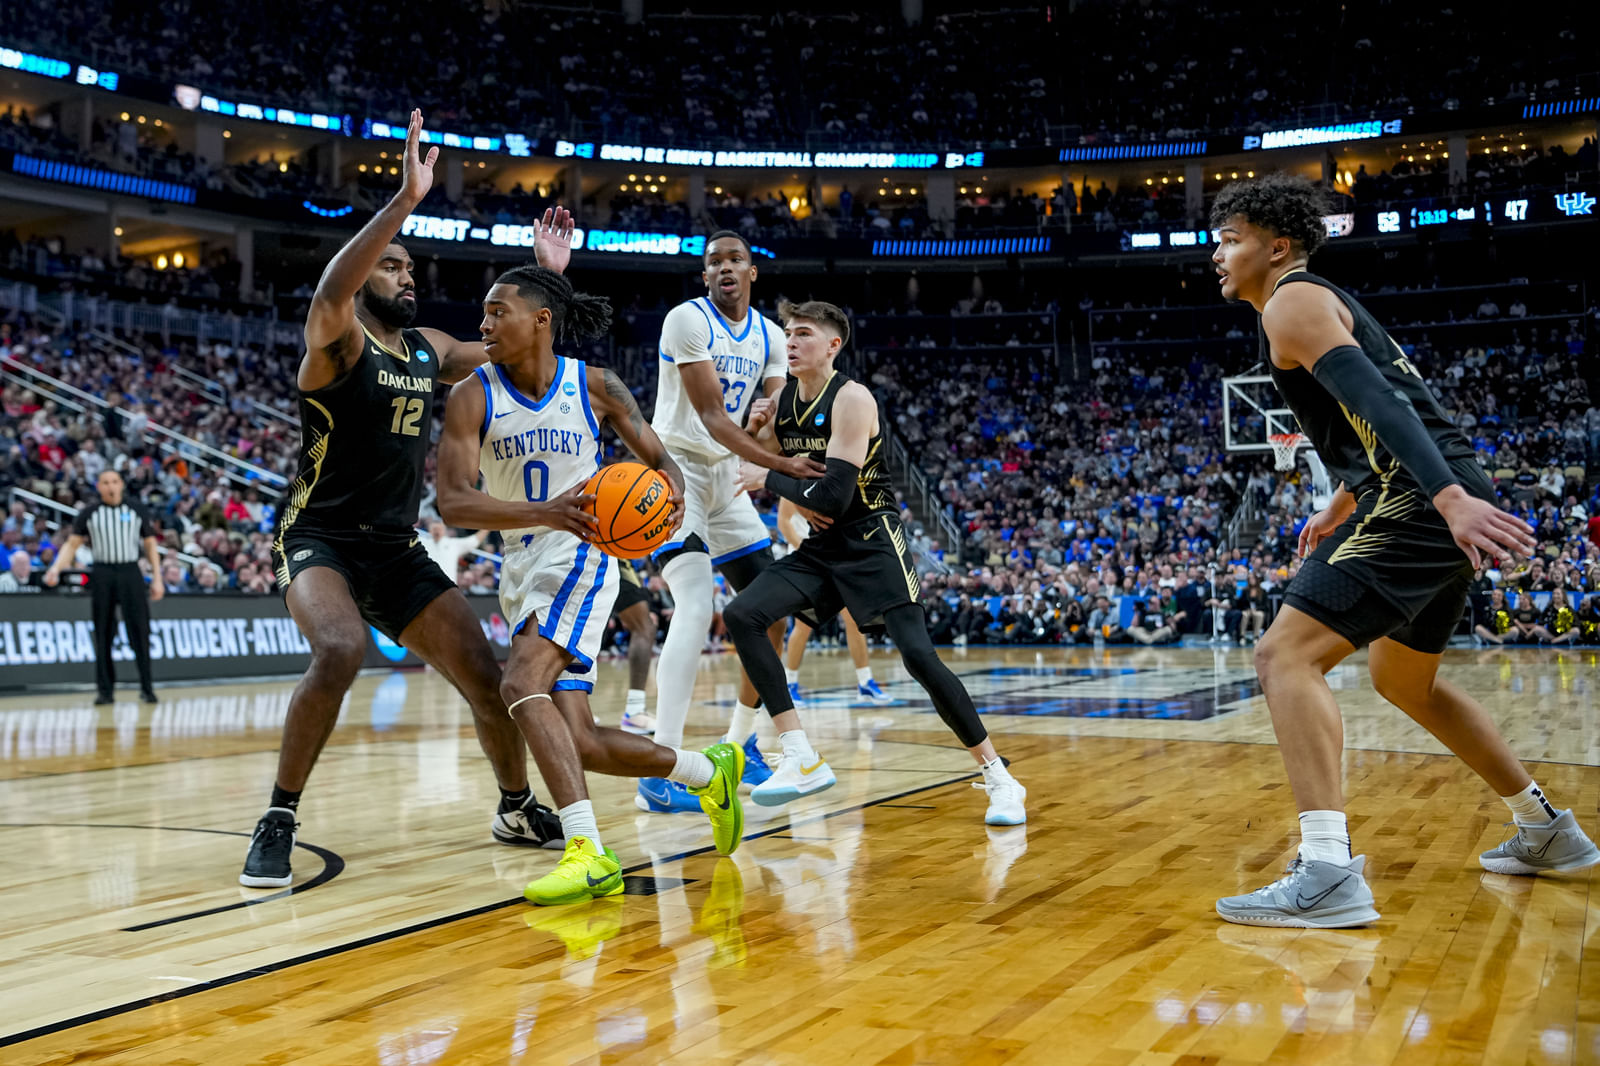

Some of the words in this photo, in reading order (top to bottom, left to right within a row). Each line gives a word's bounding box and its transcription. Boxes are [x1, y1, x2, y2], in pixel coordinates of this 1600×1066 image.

[715, 151, 813, 167] BASKETBALL
[814, 152, 938, 168] CHAMPIONSHIP
[1377, 211, 1400, 232] 52
[1504, 199, 1528, 220] 47
[401, 214, 471, 242] FIRST
[490, 223, 585, 250] SECD
[587, 229, 682, 255] ROUNDS
[377, 369, 432, 393] OAKLAND
[390, 396, 425, 437] 12
[491, 428, 583, 461] KENTUCKY
[783, 437, 827, 451] OAKLAND
[523, 460, 550, 503] 0
[634, 477, 665, 516] NCAA
